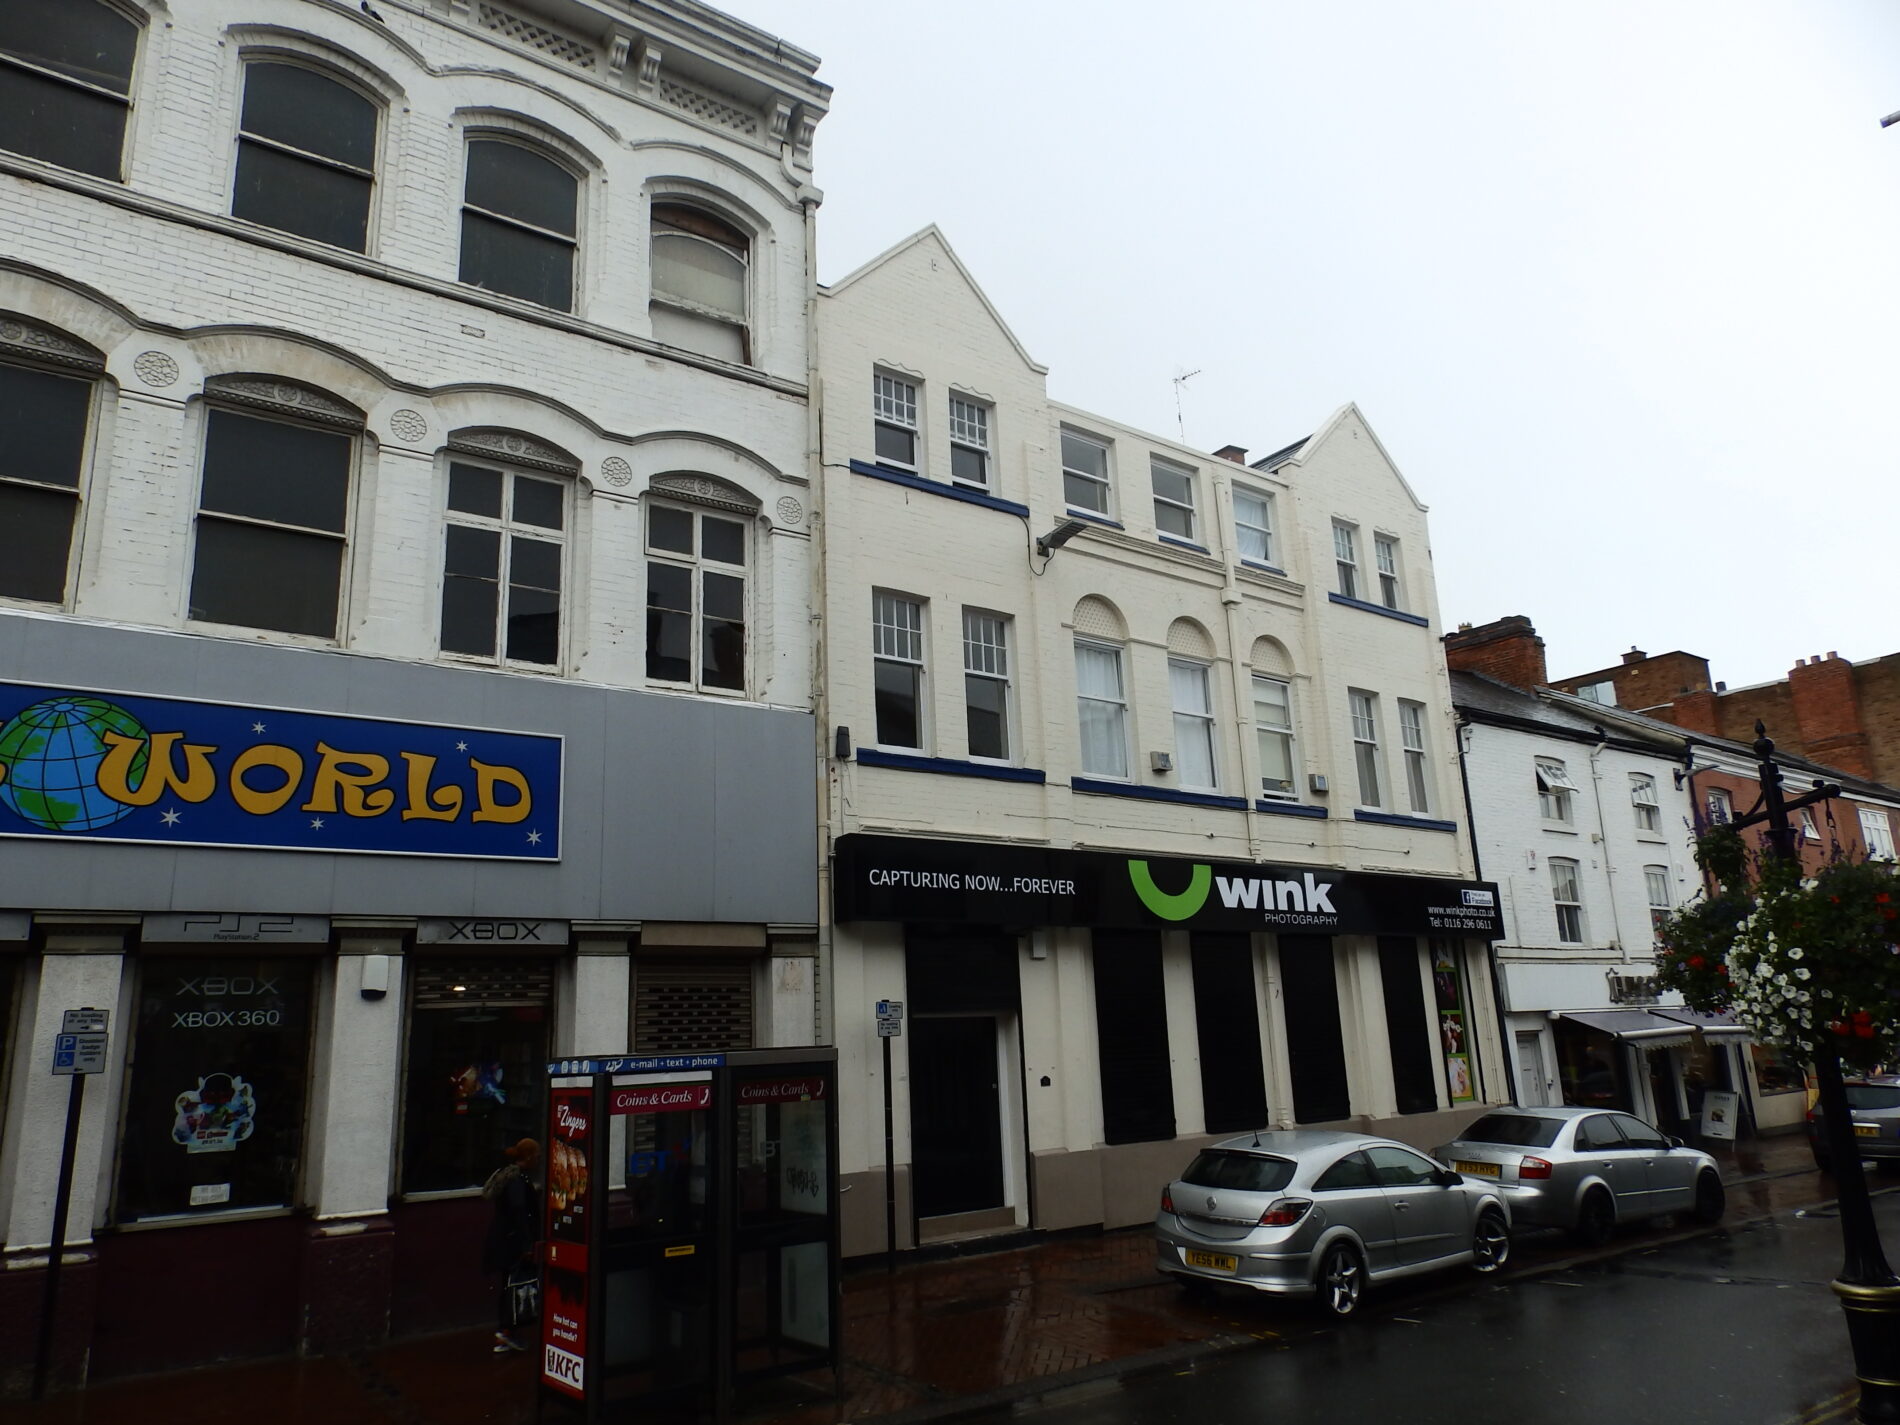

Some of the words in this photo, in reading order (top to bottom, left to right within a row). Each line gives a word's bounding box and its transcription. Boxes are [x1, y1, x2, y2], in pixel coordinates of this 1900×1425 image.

[96, 730, 534, 825] WORLD
[869, 868, 960, 890] CAPTURING
[1214, 872, 1338, 914] wink
[1265, 912, 1339, 926] PHOTOGRAPHY
[1429, 917, 1443, 928] Tel:
[1444, 917, 1462, 929] 0116
[447, 920, 542, 940] XBOX
[177, 977, 279, 995] XBOX
[172, 1011, 235, 1028] XBOX
[238, 1009, 280, 1026] 360
[62, 1037, 74, 1050] P
[630, 1058, 658, 1070] e-mail
[666, 1058, 684, 1068] text
[691, 1056, 718, 1068] phone
[616, 1092, 649, 1109] Coins
[650, 1092, 660, 1105] &
[660, 1088, 693, 1105] Cards
[741, 1085, 770, 1100] Coins
[780, 1081, 810, 1098] Cards
[560, 1105, 588, 1137] Zingers
[555, 1352, 581, 1384] KFC
